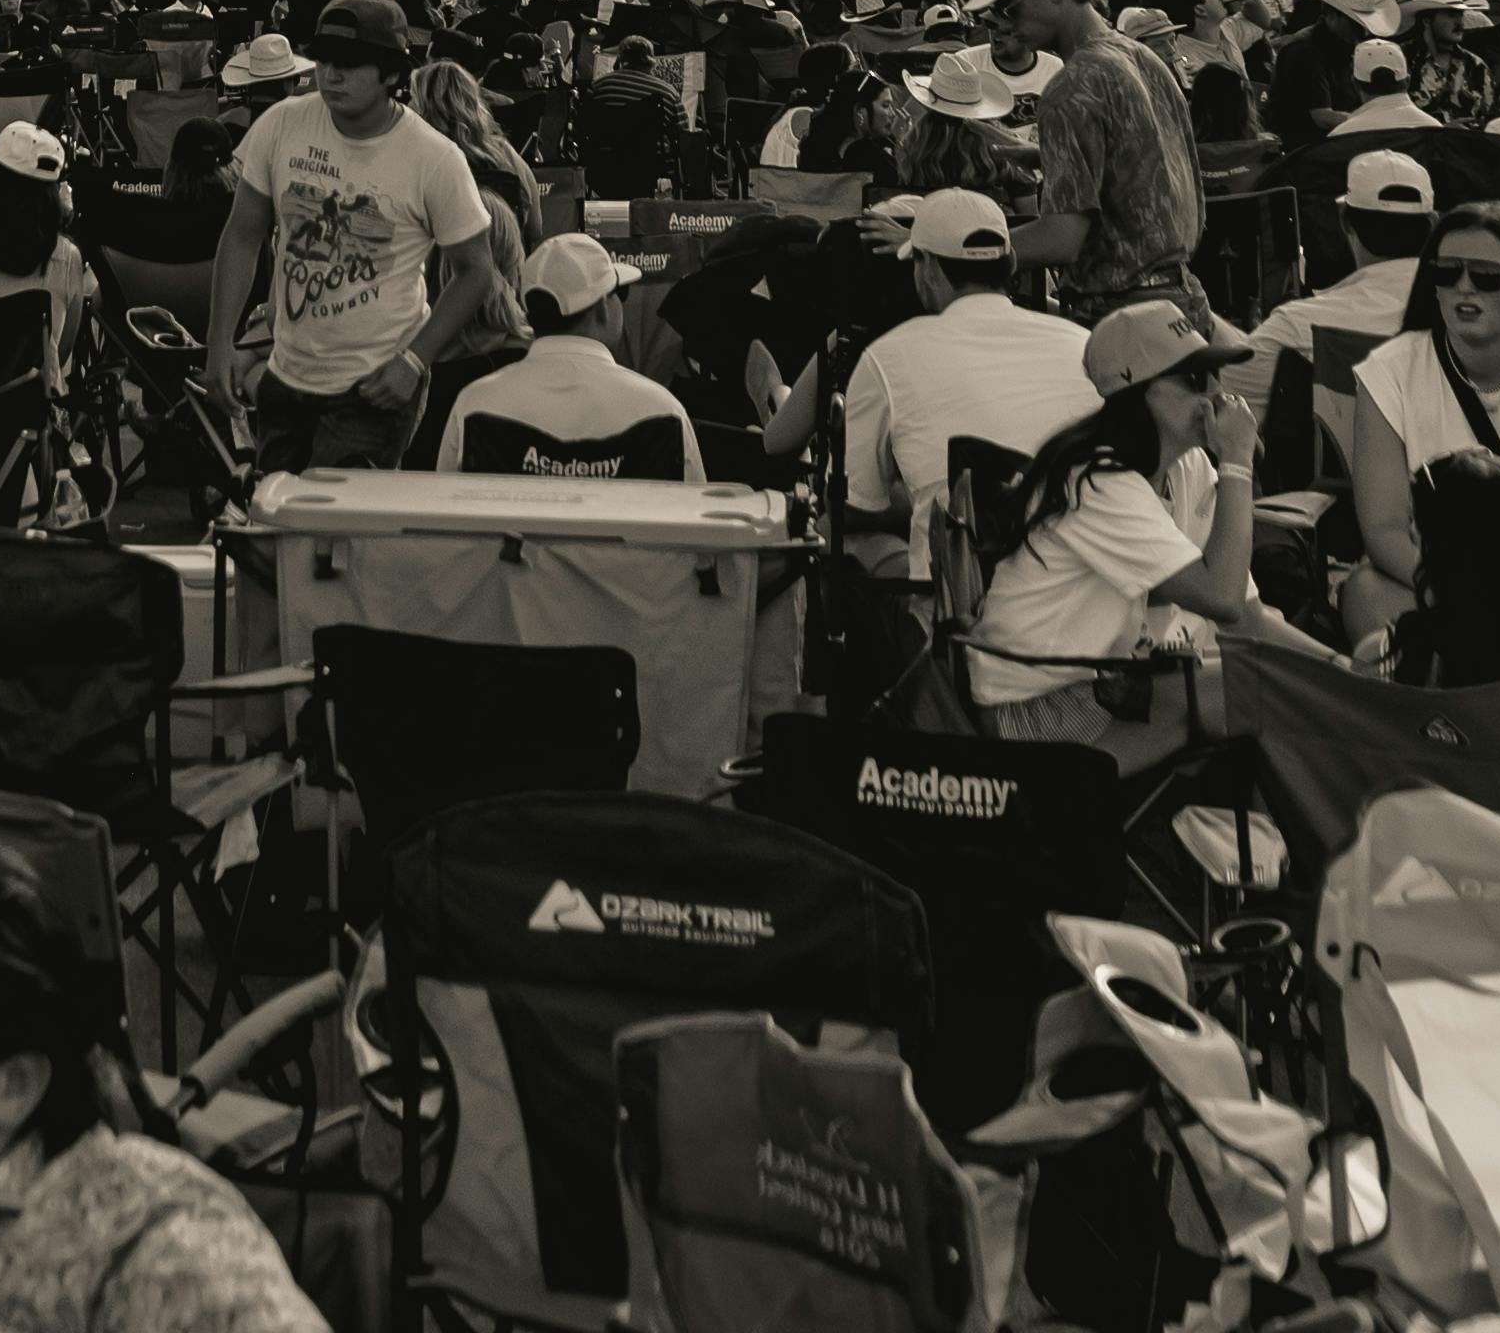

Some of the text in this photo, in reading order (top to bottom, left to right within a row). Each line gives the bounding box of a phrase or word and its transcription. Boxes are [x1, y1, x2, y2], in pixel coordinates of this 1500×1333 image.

[289, 156, 342, 180] ORIGINAL
[308, 145, 330, 162] THE
[112, 180, 161, 194] Academ
[283, 253, 380, 322] Coors
[311, 286, 381, 319] COWBOY
[522, 446, 622, 480] Academy
[857, 757, 1010, 816] Academy
